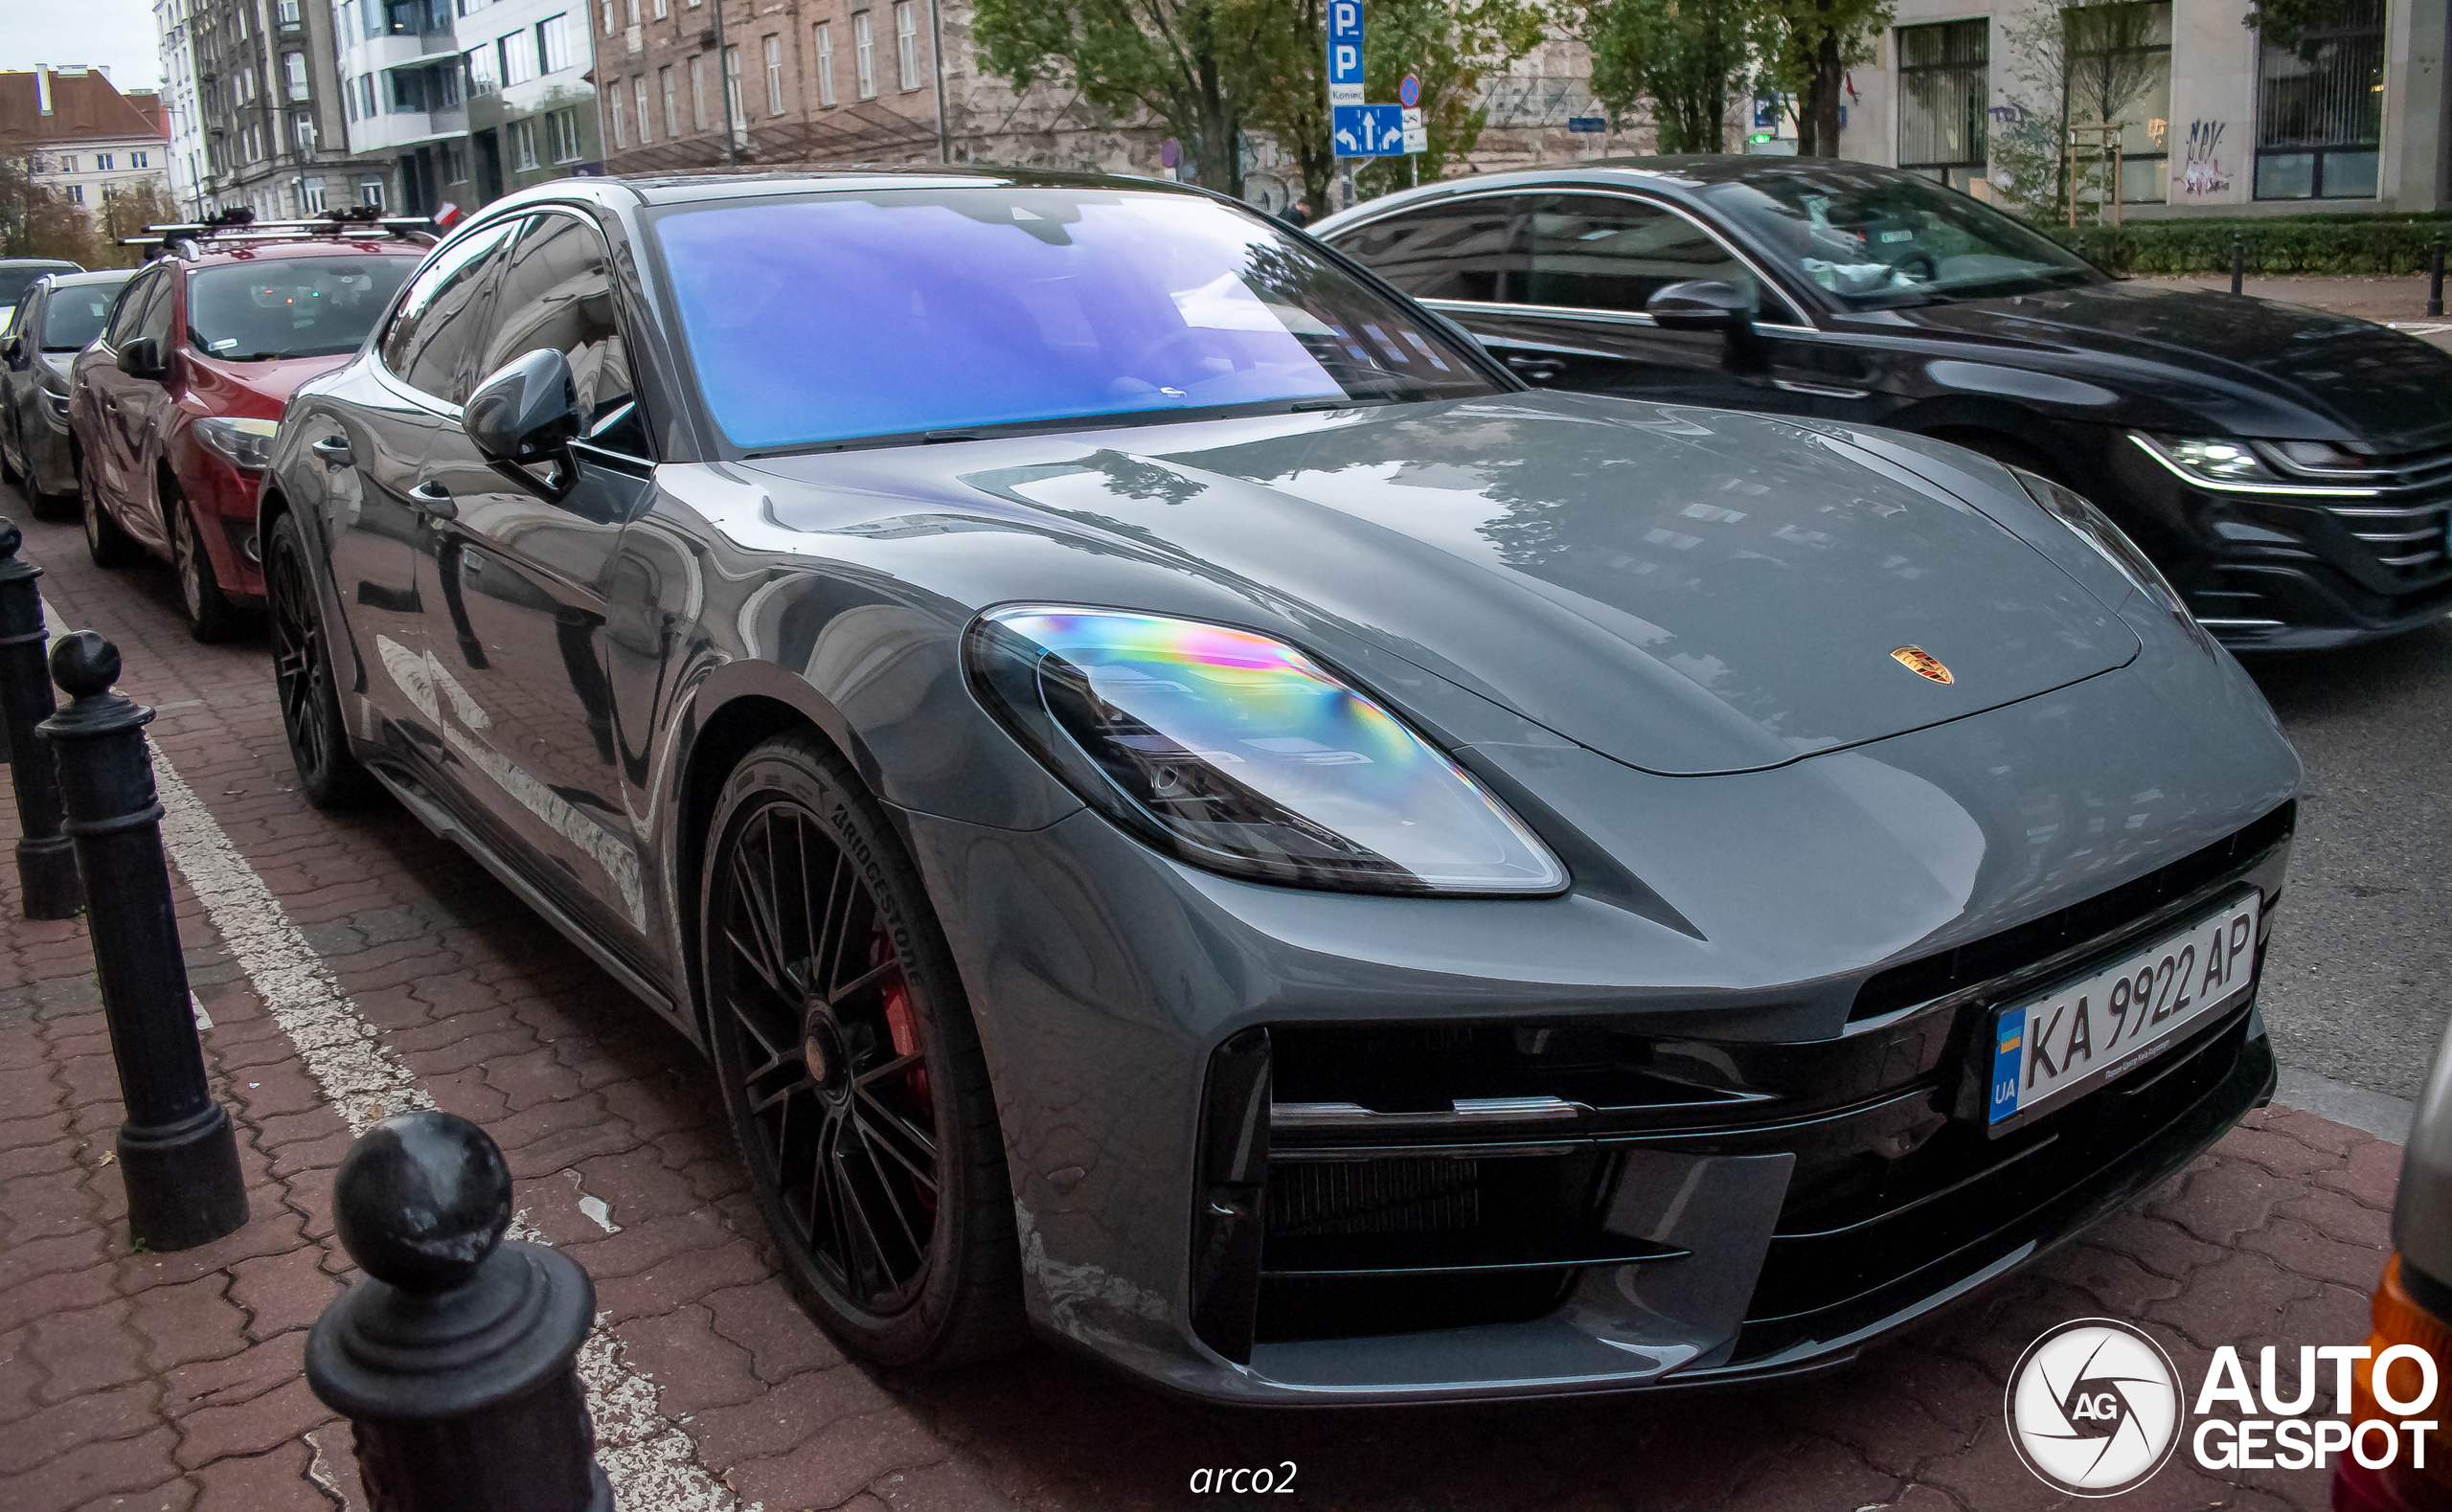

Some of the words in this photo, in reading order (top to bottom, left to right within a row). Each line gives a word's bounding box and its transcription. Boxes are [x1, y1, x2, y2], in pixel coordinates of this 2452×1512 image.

[1335, 3, 1356, 36] P
[1335, 45, 1357, 79] P
[1332, 90, 1363, 101] Koniec
[1292, 819, 1333, 841] PORSCHE
[2026, 996, 2092, 1090] KA
[2105, 943, 2195, 1050] 9922
[2199, 912, 2251, 1000] AP
[1994, 1078, 2016, 1105] UA
